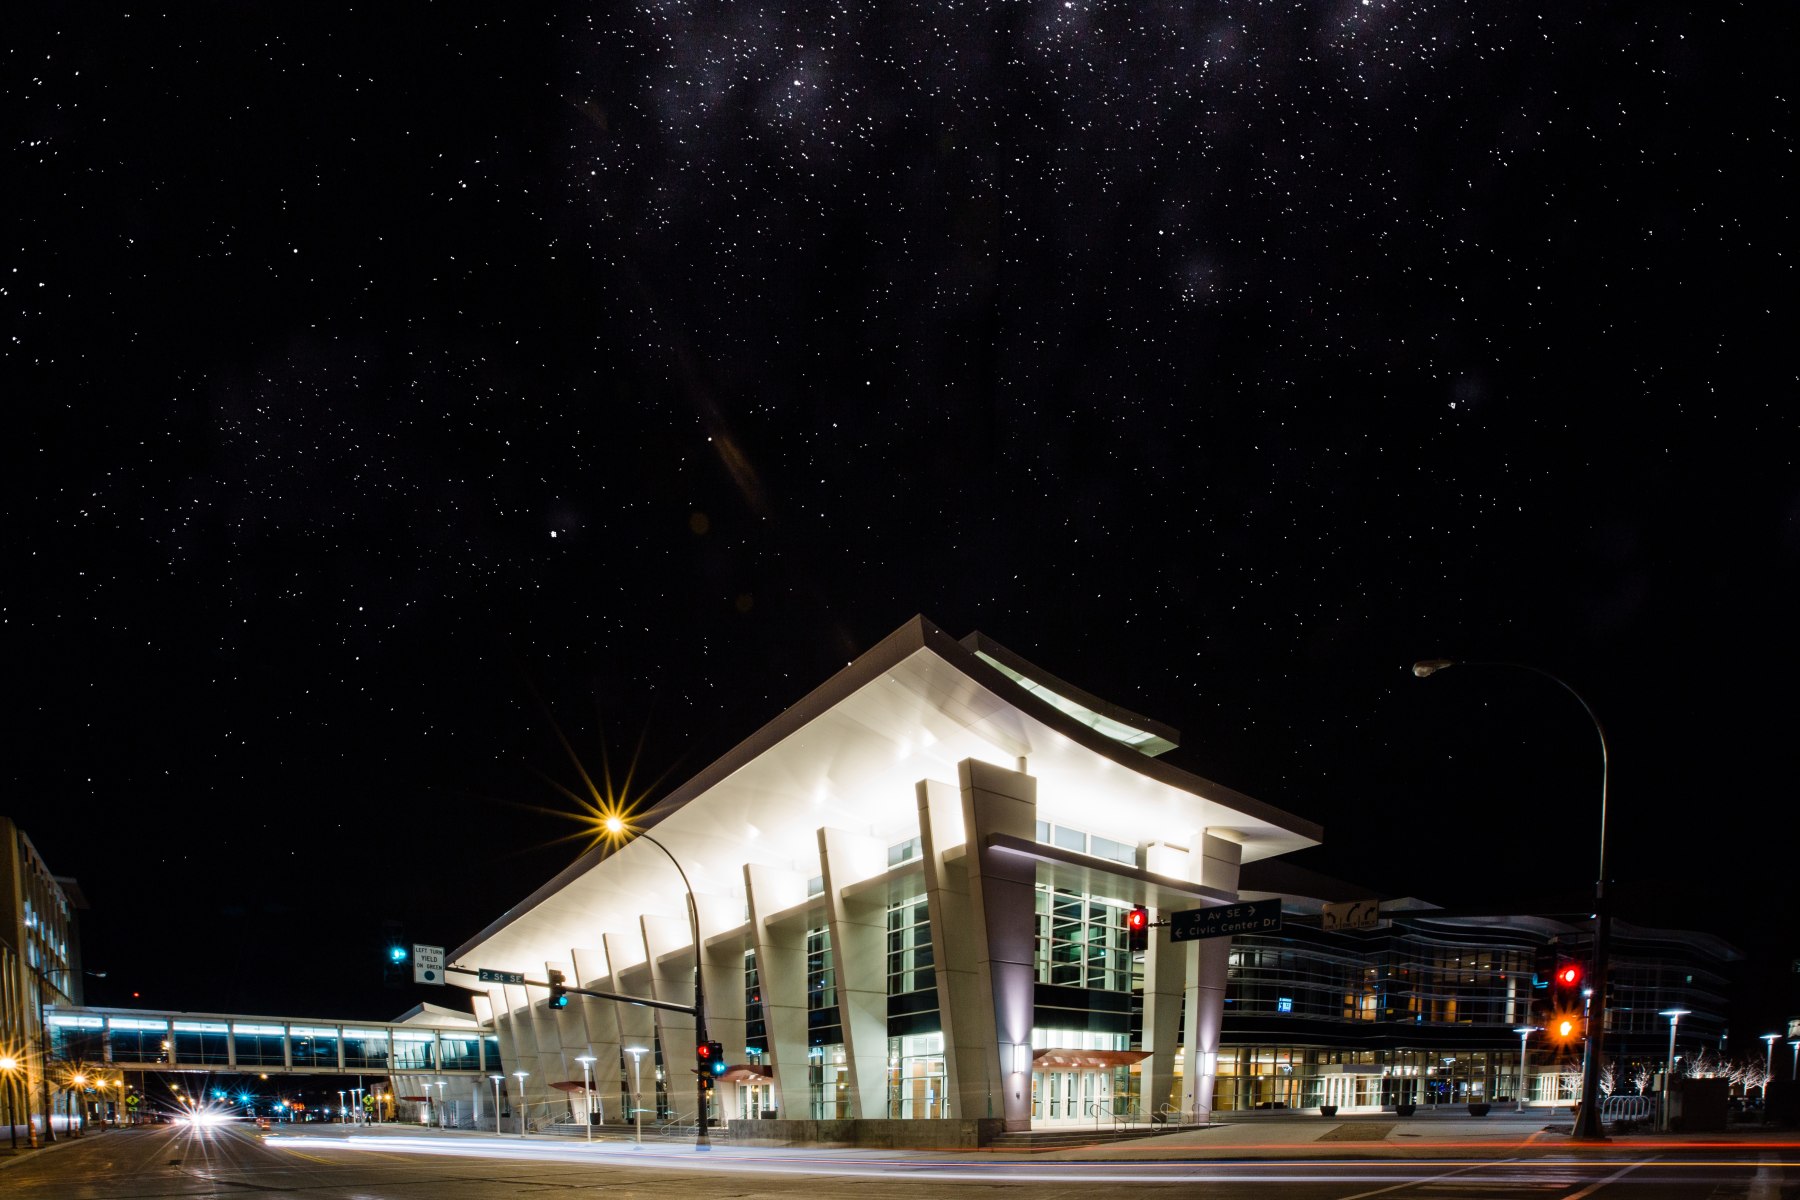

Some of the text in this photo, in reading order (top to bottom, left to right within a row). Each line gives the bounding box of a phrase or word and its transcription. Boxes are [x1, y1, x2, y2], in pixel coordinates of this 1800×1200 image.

[1193, 908, 1241, 922] 3 Av SE
[1189, 917, 1278, 936] Civic Center Dr
[421, 955, 438, 963] YIELD
[482, 972, 522, 983] 2 St SE
